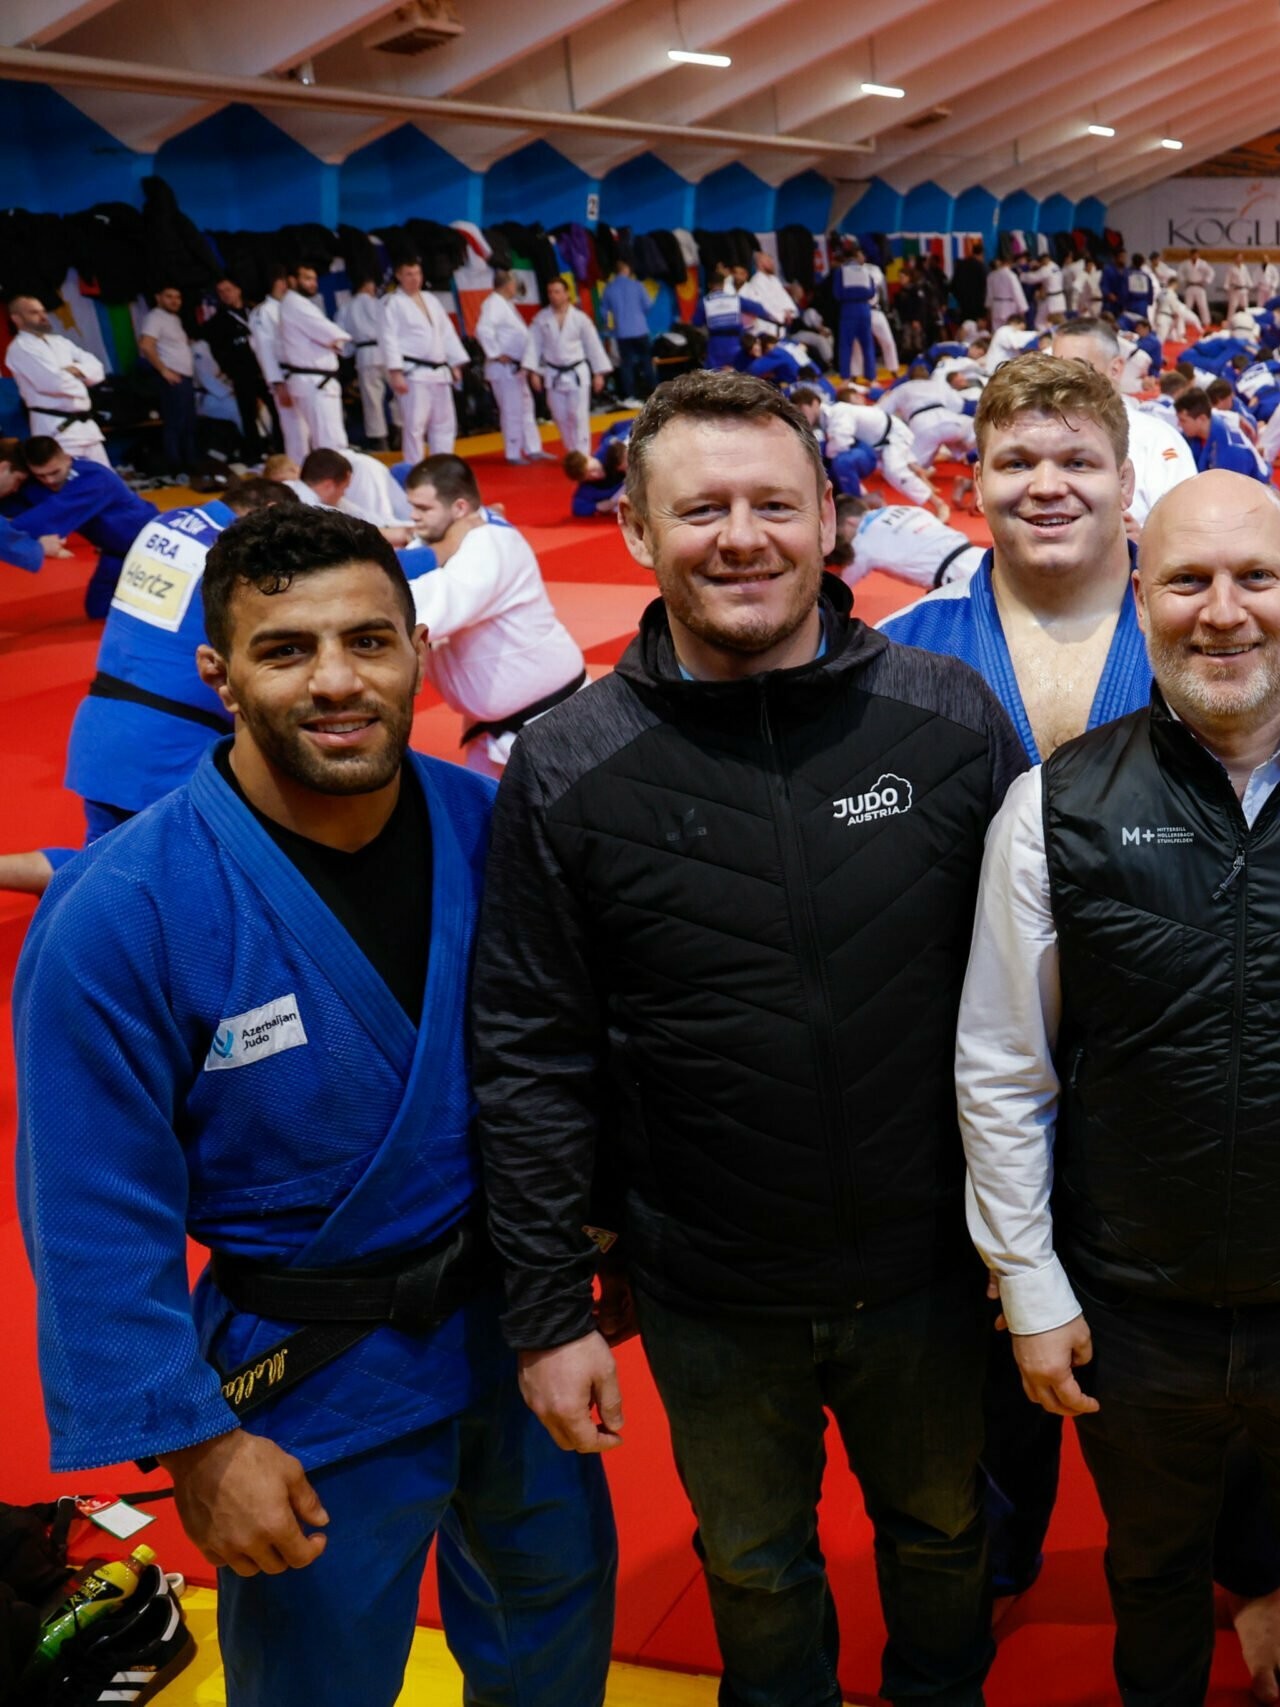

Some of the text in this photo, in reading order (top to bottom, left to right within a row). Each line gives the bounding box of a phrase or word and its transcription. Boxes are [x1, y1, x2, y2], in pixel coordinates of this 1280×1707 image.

[145, 533, 180, 560] BRA
[126, 560, 176, 600] Hertz
[832, 787, 899, 819] JUDO
[847, 805, 901, 827] AUSTRIA
[241, 1012, 298, 1040] Azerbaijan
[243, 1034, 270, 1051] Judo
